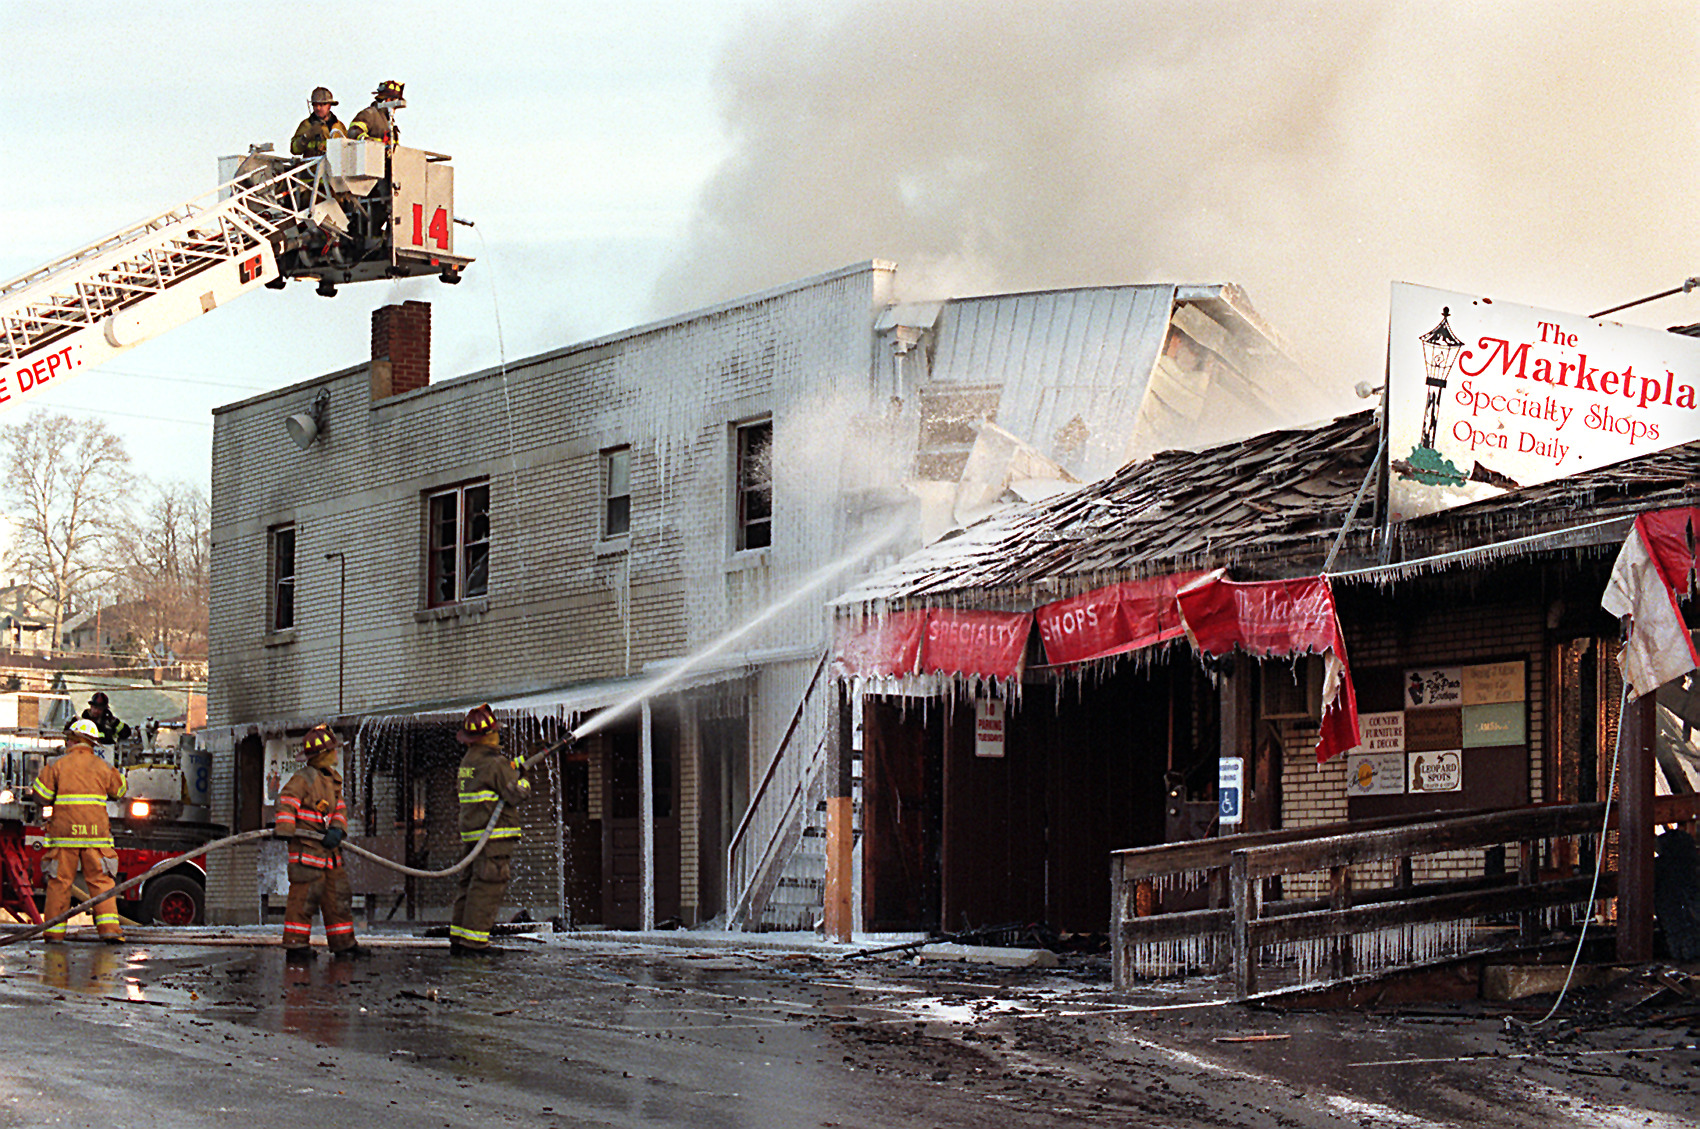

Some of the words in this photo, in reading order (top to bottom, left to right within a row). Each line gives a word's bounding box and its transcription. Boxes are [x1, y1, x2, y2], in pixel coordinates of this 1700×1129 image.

[412, 203, 449, 250] 14
[1537, 321, 1578, 347] The
[16, 345, 82, 393] DEPT.
[1459, 336, 1698, 410] Marketpla
[1455, 380, 1573, 431] Specialty
[1584, 403, 1660, 445] Shops
[1453, 420, 1508, 451] Open
[1518, 432, 1570, 466] Daily
[928, 619, 1018, 647] SPECIALTY
[1041, 603, 1099, 642] SHOPS
[1366, 727, 1403, 738] FURNITURE
[1369, 716, 1399, 726] COUNTRY
[1377, 738, 1399, 749] DECOR
[196, 767, 208, 793] 8
[1421, 763, 1457, 774] LEOPARD
[1427, 773, 1451, 782] SPOTS
[71, 824, 88, 836] STA
